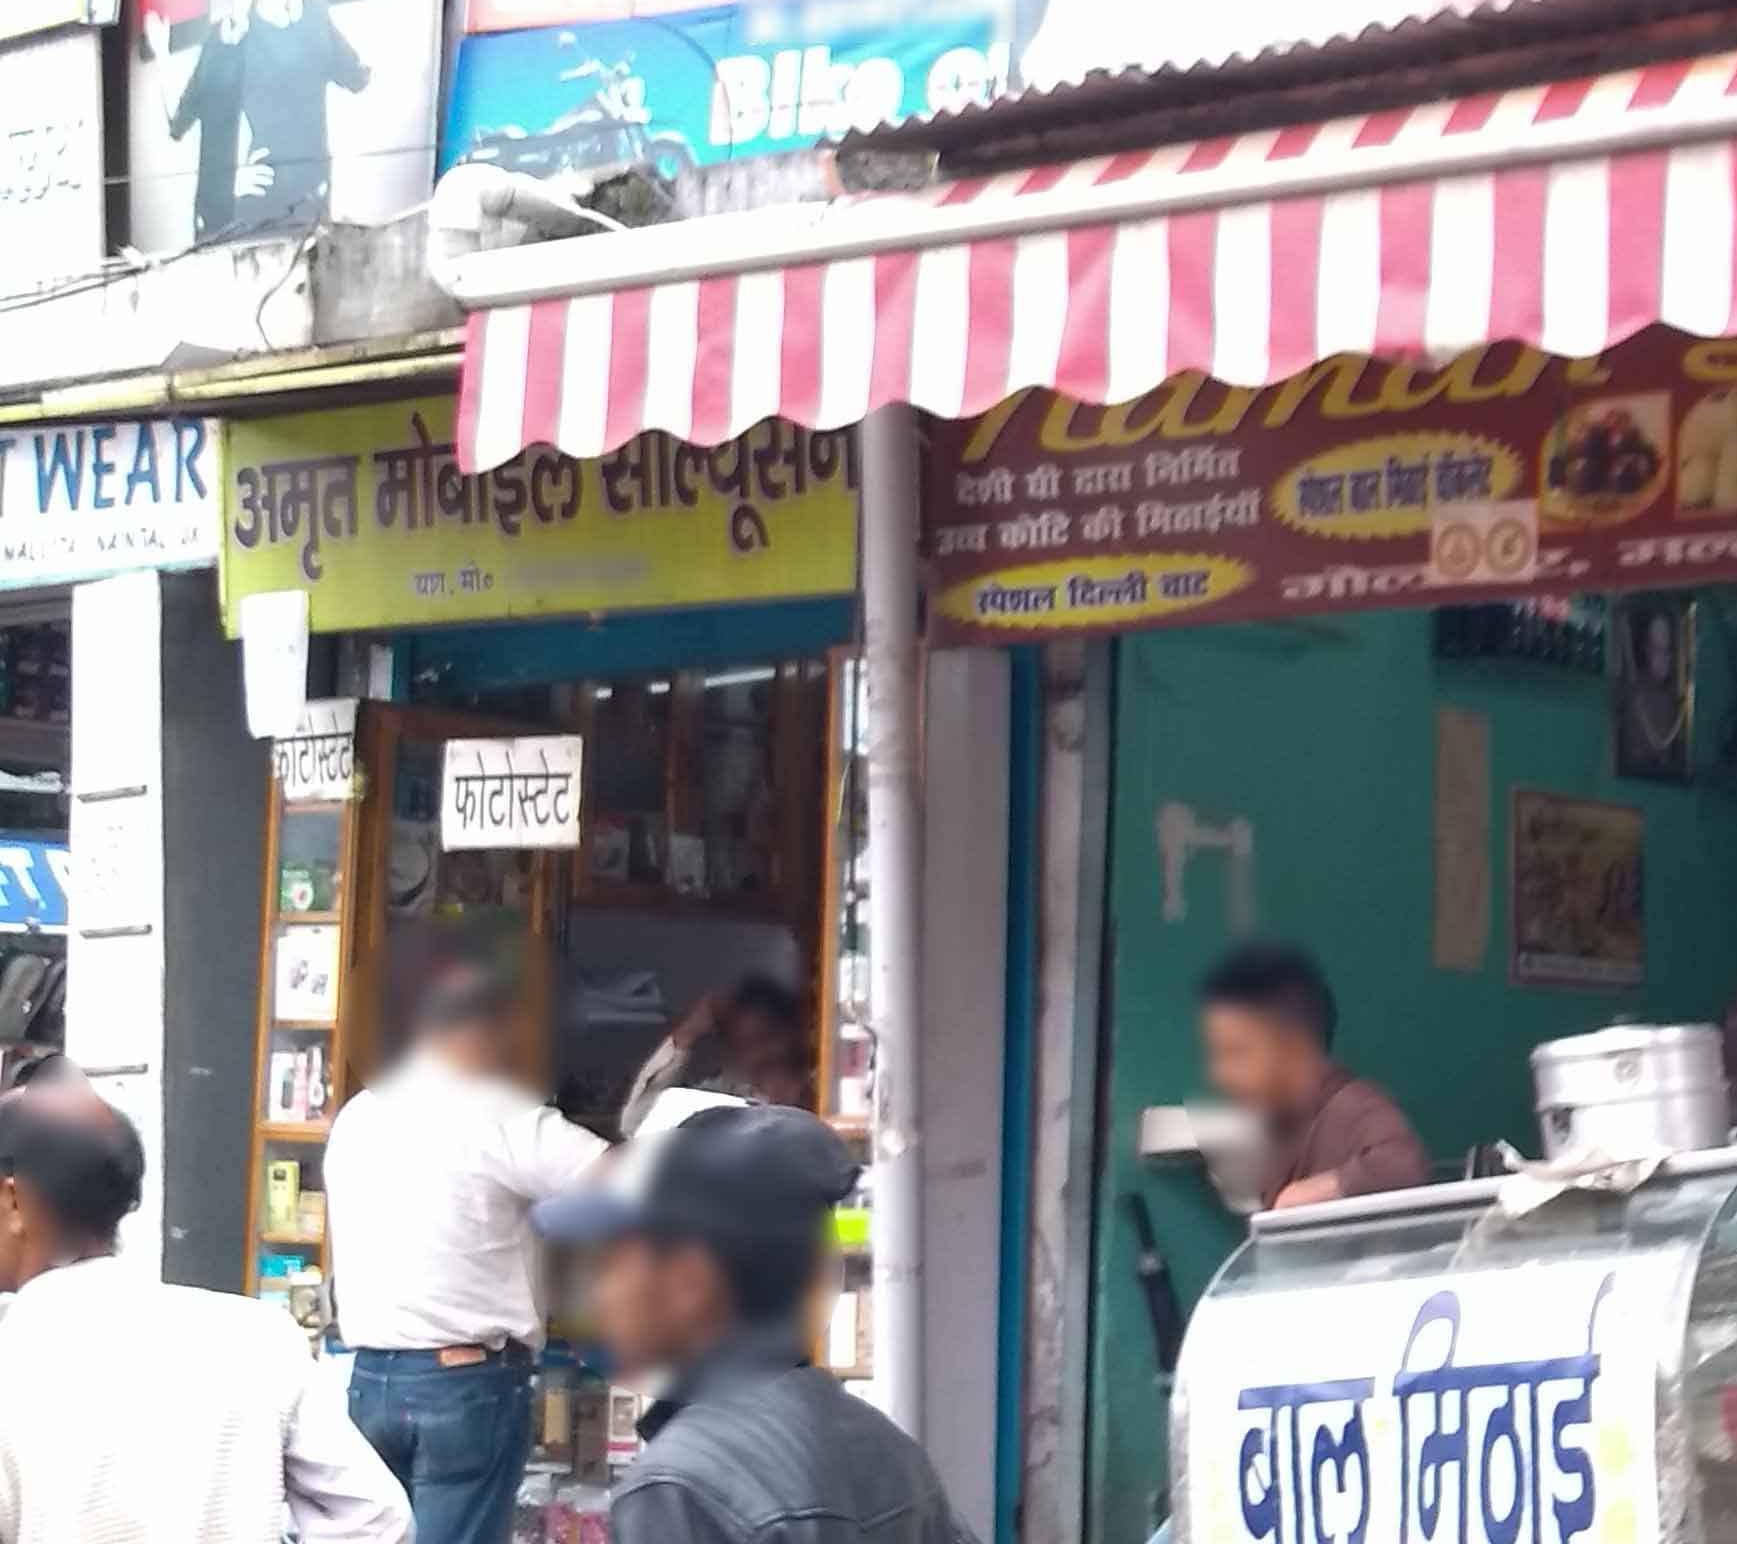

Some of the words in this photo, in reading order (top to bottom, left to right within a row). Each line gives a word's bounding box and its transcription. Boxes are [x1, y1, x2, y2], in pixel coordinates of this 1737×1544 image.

[710, 45, 904, 146] Bike
[34, 417, 208, 514] WEAR
[234, 454, 359, 580] अमृत
[373, 412, 583, 536] मोबाइल
[1080, 505, 1126, 541] की
[1066, 571, 1148, 608] दिल्ली
[1159, 571, 1212, 600] चाट
[455, 752, 573, 830] फोटोस्टेट
